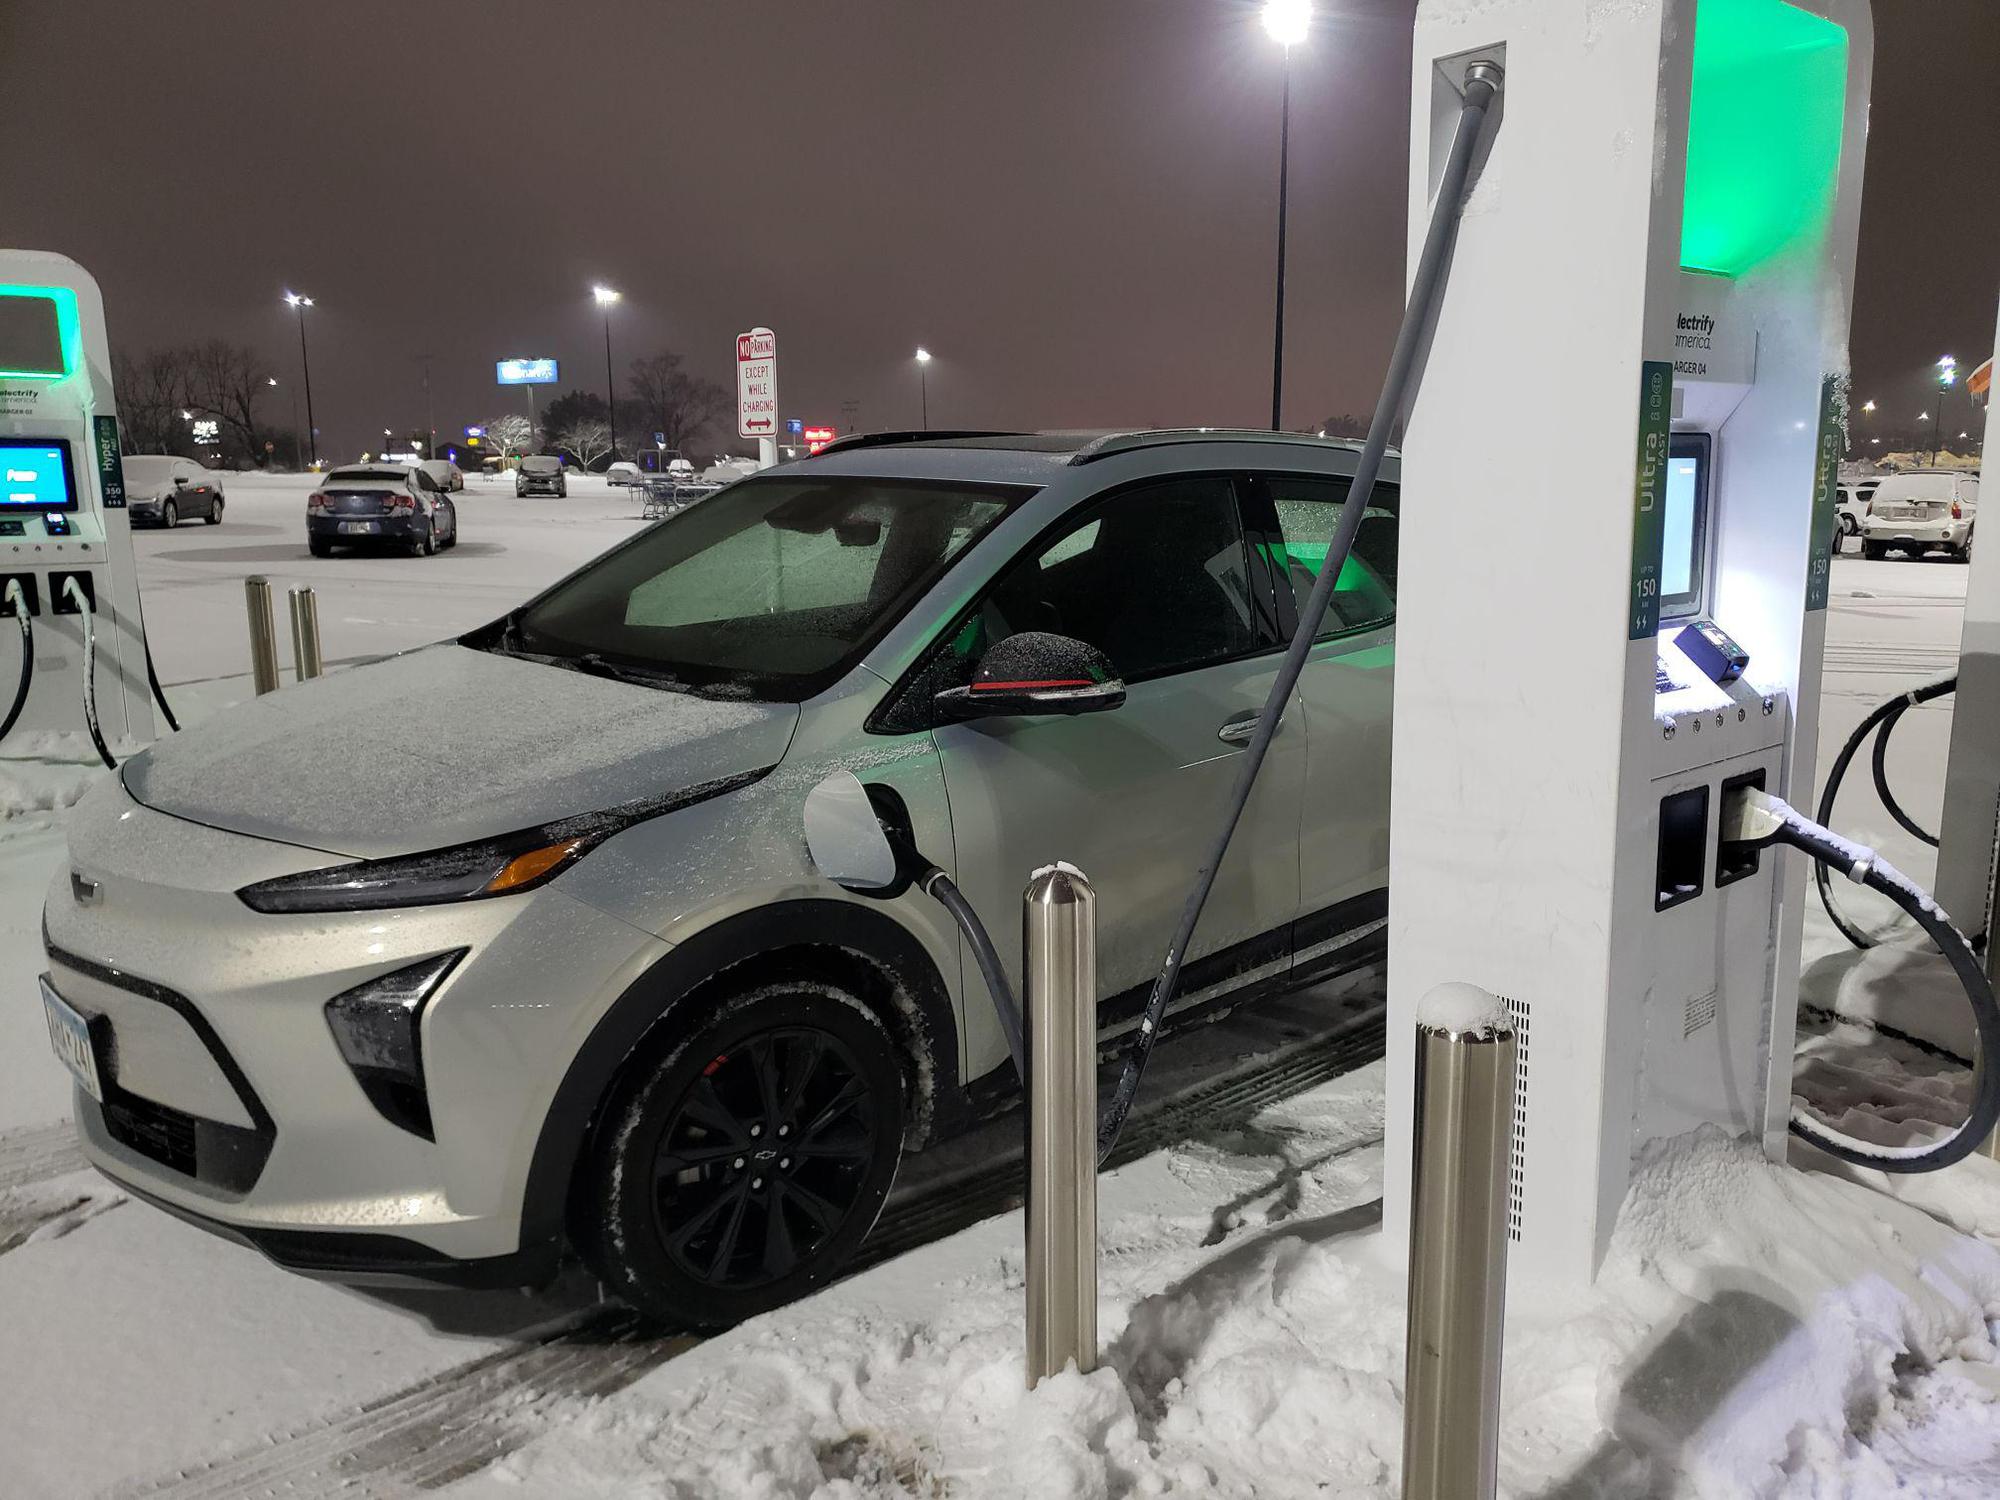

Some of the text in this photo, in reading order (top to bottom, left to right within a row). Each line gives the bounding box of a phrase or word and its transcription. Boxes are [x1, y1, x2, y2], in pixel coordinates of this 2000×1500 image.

[1677, 313, 1715, 335] lectrify
[740, 339, 773, 357] NO PARKING
[745, 366, 769, 379] EXCEPT
[1674, 361, 1707, 375] ARGER 04
[748, 383, 768, 395] WHILE
[743, 400, 774, 413] CHARGING
[101, 438, 114, 472] Hyper
[1658, 432, 1666, 466] FAST
[1641, 432, 1657, 512] Ultra
[105, 487, 122, 495] 350
[1814, 558, 1827, 575] 150
[1637, 578, 1656, 598] 150
